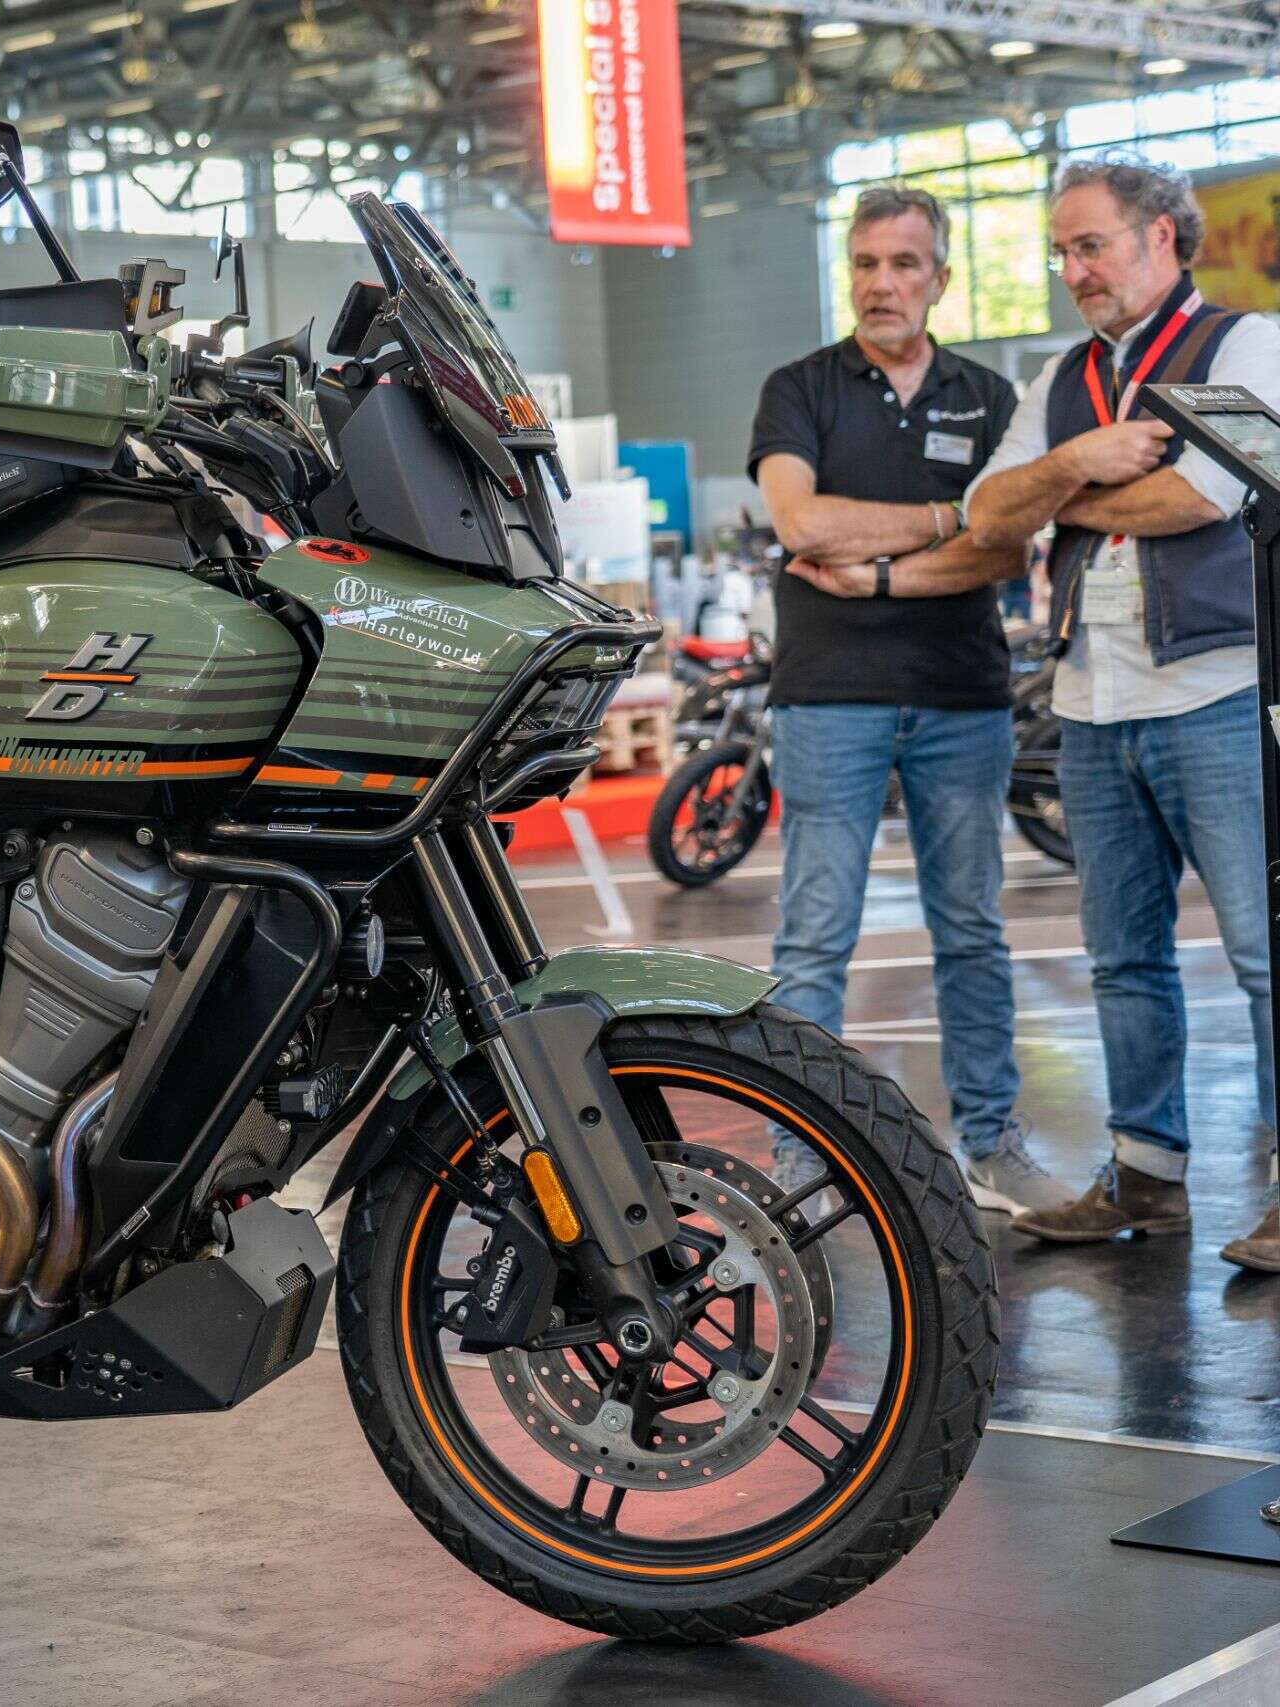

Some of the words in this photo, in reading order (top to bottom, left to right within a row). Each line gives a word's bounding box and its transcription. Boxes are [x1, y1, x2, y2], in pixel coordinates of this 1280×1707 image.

[584, 36, 626, 212] Special
[371, 586, 470, 631] Wunderlich
[63, 631, 155, 671] H
[364, 617, 482, 665] Harleyworld
[24, 683, 107, 722] D
[8, 745, 147, 777] UNLIMITED
[481, 1245, 516, 1313] brembo
